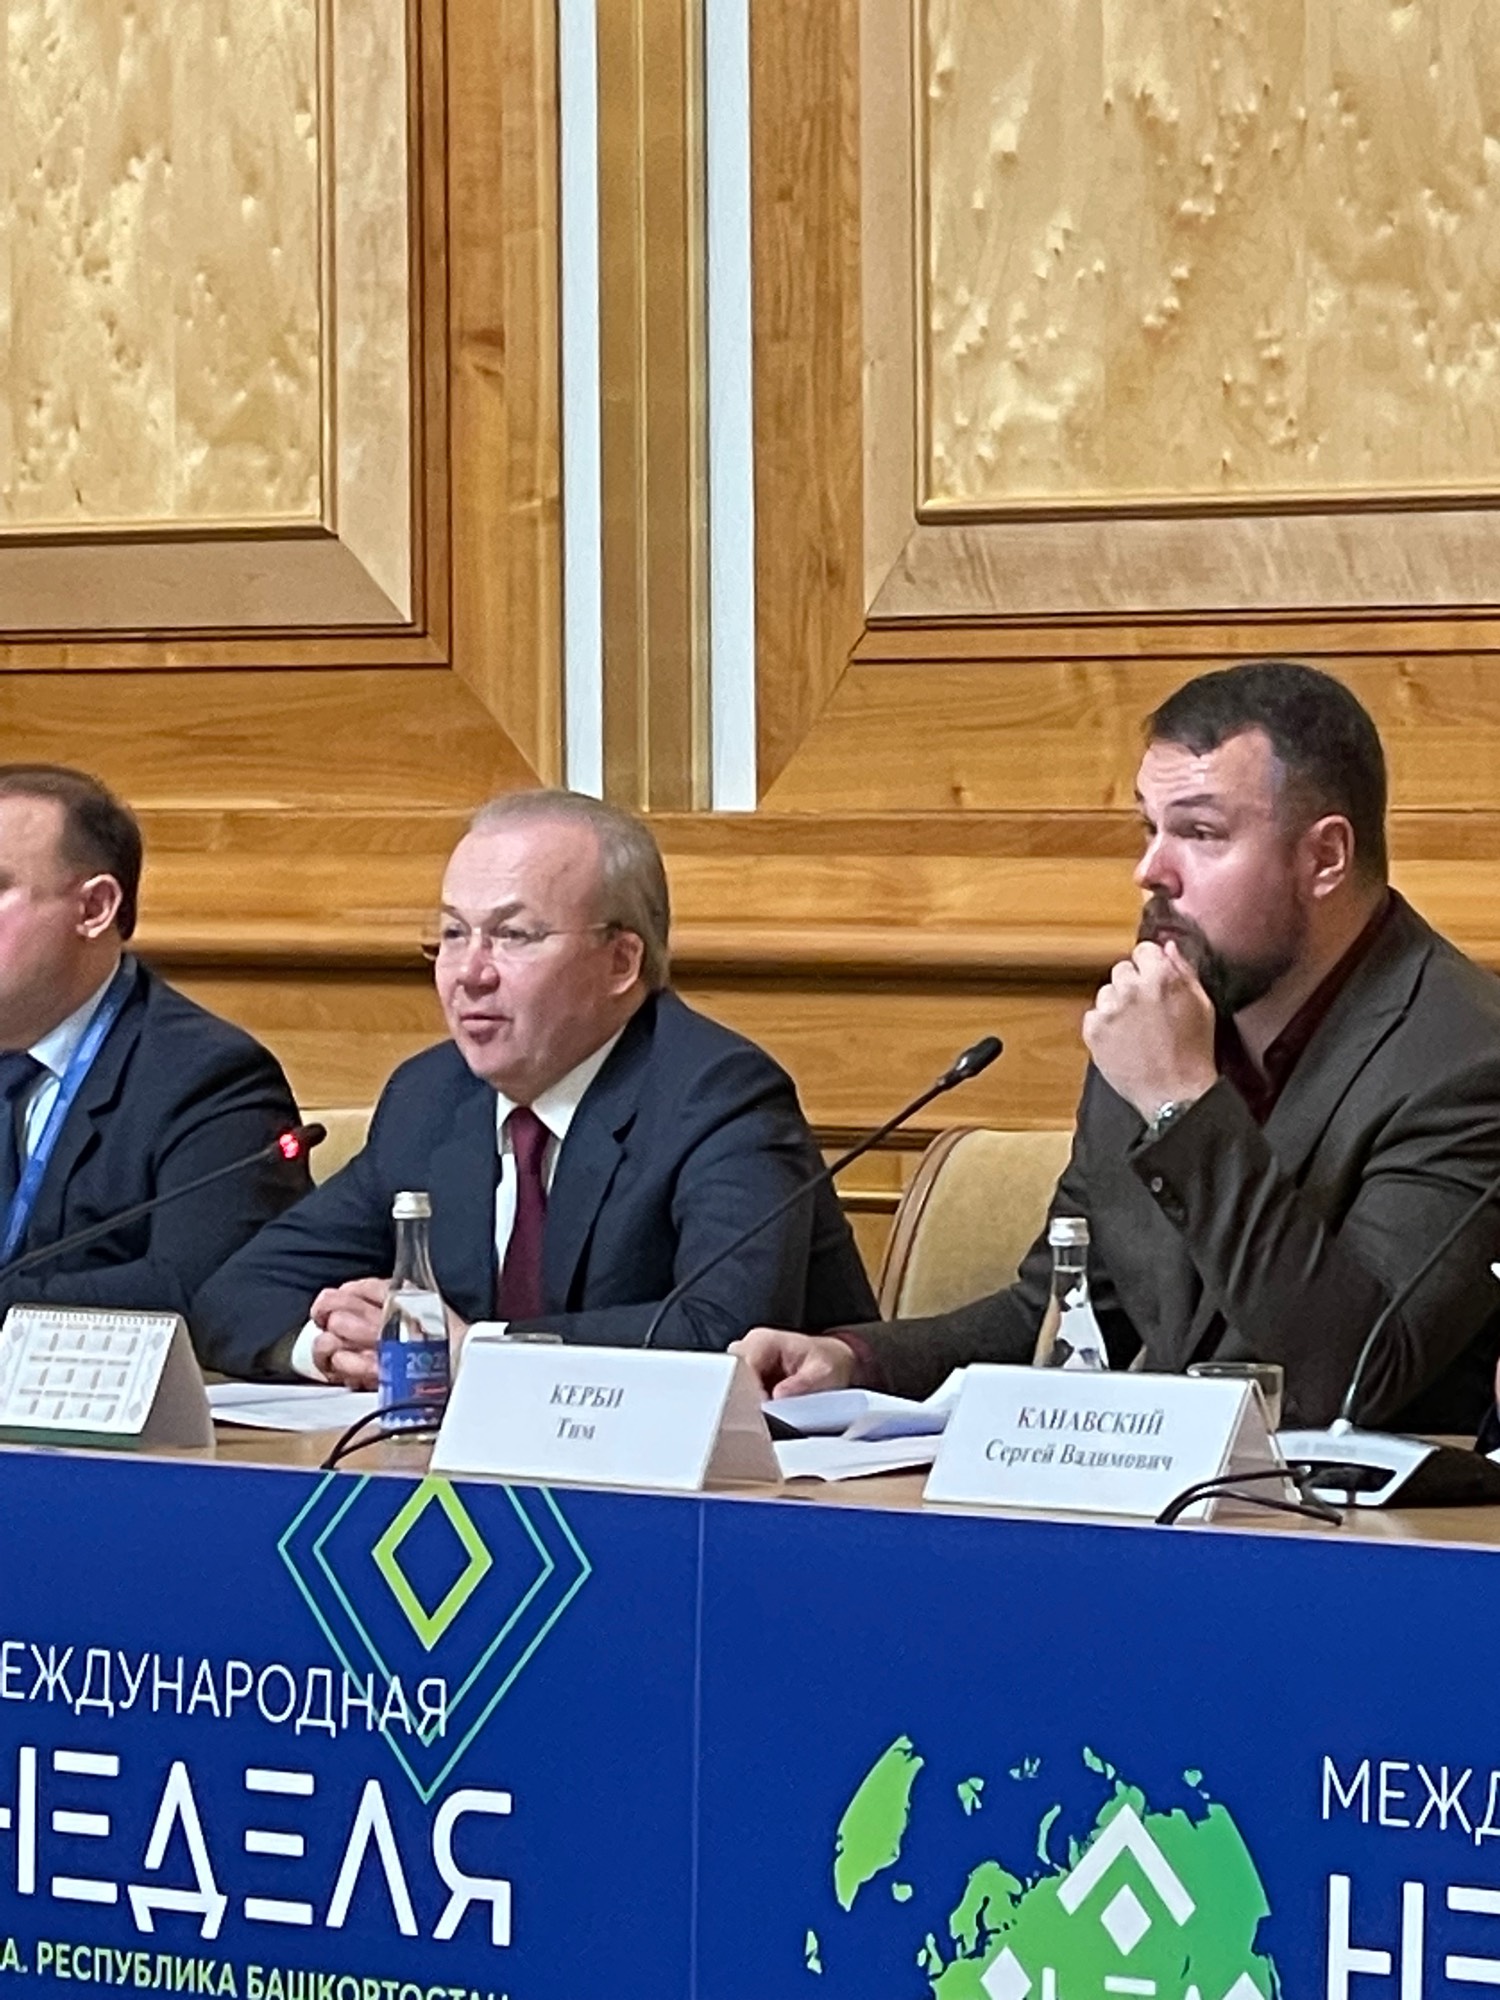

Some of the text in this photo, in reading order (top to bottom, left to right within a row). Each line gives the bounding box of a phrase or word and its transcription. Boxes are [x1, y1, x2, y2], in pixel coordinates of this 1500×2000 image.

[550, 1384, 625, 1409] КЕРБИ
[556, 1417, 596, 1440] Тим
[1017, 1406, 1165, 1435] КАНАВСКИЙ
[985, 1438, 1174, 1472] Сергей Вадимович
[0, 1640, 447, 1738] ЕЖДУНАРОДНАЯ
[37, 1941, 238, 1999] РЕСПУБЛИКА
[247, 1965, 508, 2000] БАШКОРТ
